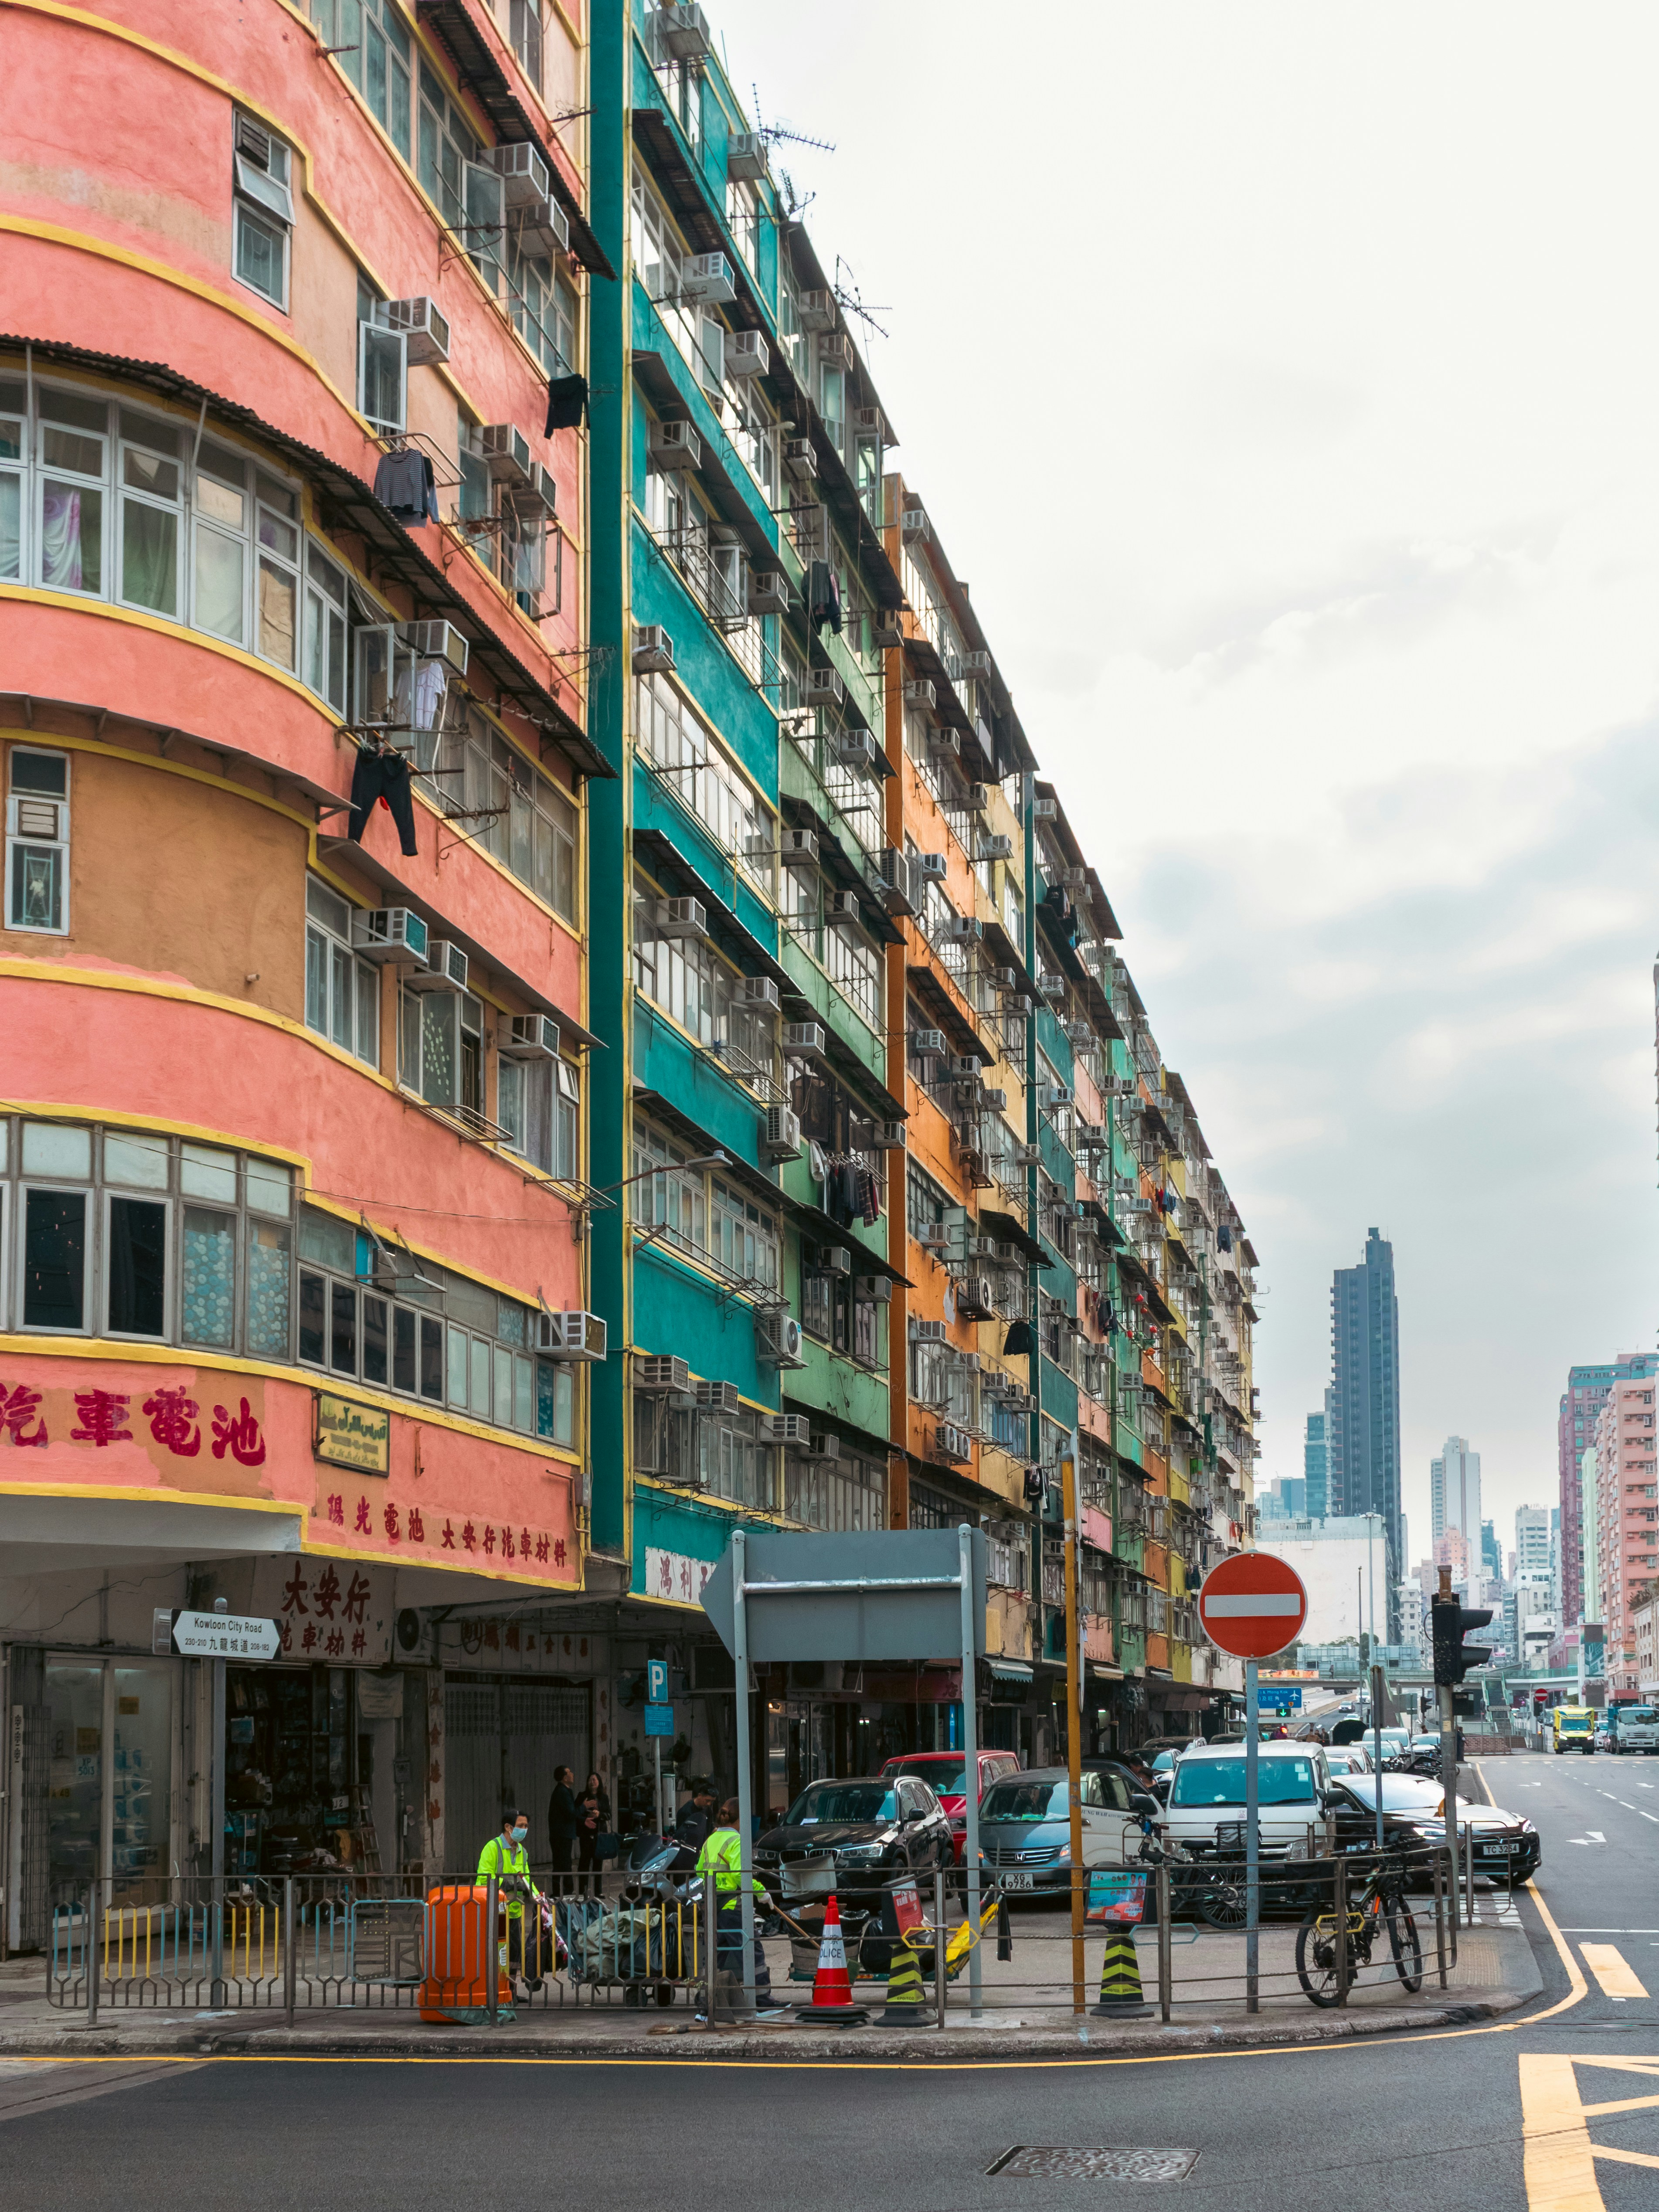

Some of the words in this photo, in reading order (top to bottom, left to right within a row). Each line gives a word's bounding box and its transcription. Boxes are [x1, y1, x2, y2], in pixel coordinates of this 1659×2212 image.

[0, 1382, 266, 1466] 汽車電池
[327, 1493, 425, 1543] 陽光電池
[440, 1518, 567, 1568] 大安行汽車材料
[281, 1560, 371, 1625] 大安行
[194, 1617, 226, 1630] Kowloon
[228, 1621, 242, 1633] City
[245, 1622, 262, 1633] Road
[185, 1638, 207, 1646] 230-210
[209, 1636, 248, 1652] 九龍城道
[652, 1665, 663, 1697] P
[83, 1757, 91, 1767] XP
[78, 1767, 94, 1776] 5013
[820, 1948, 841, 1958] OLICE
